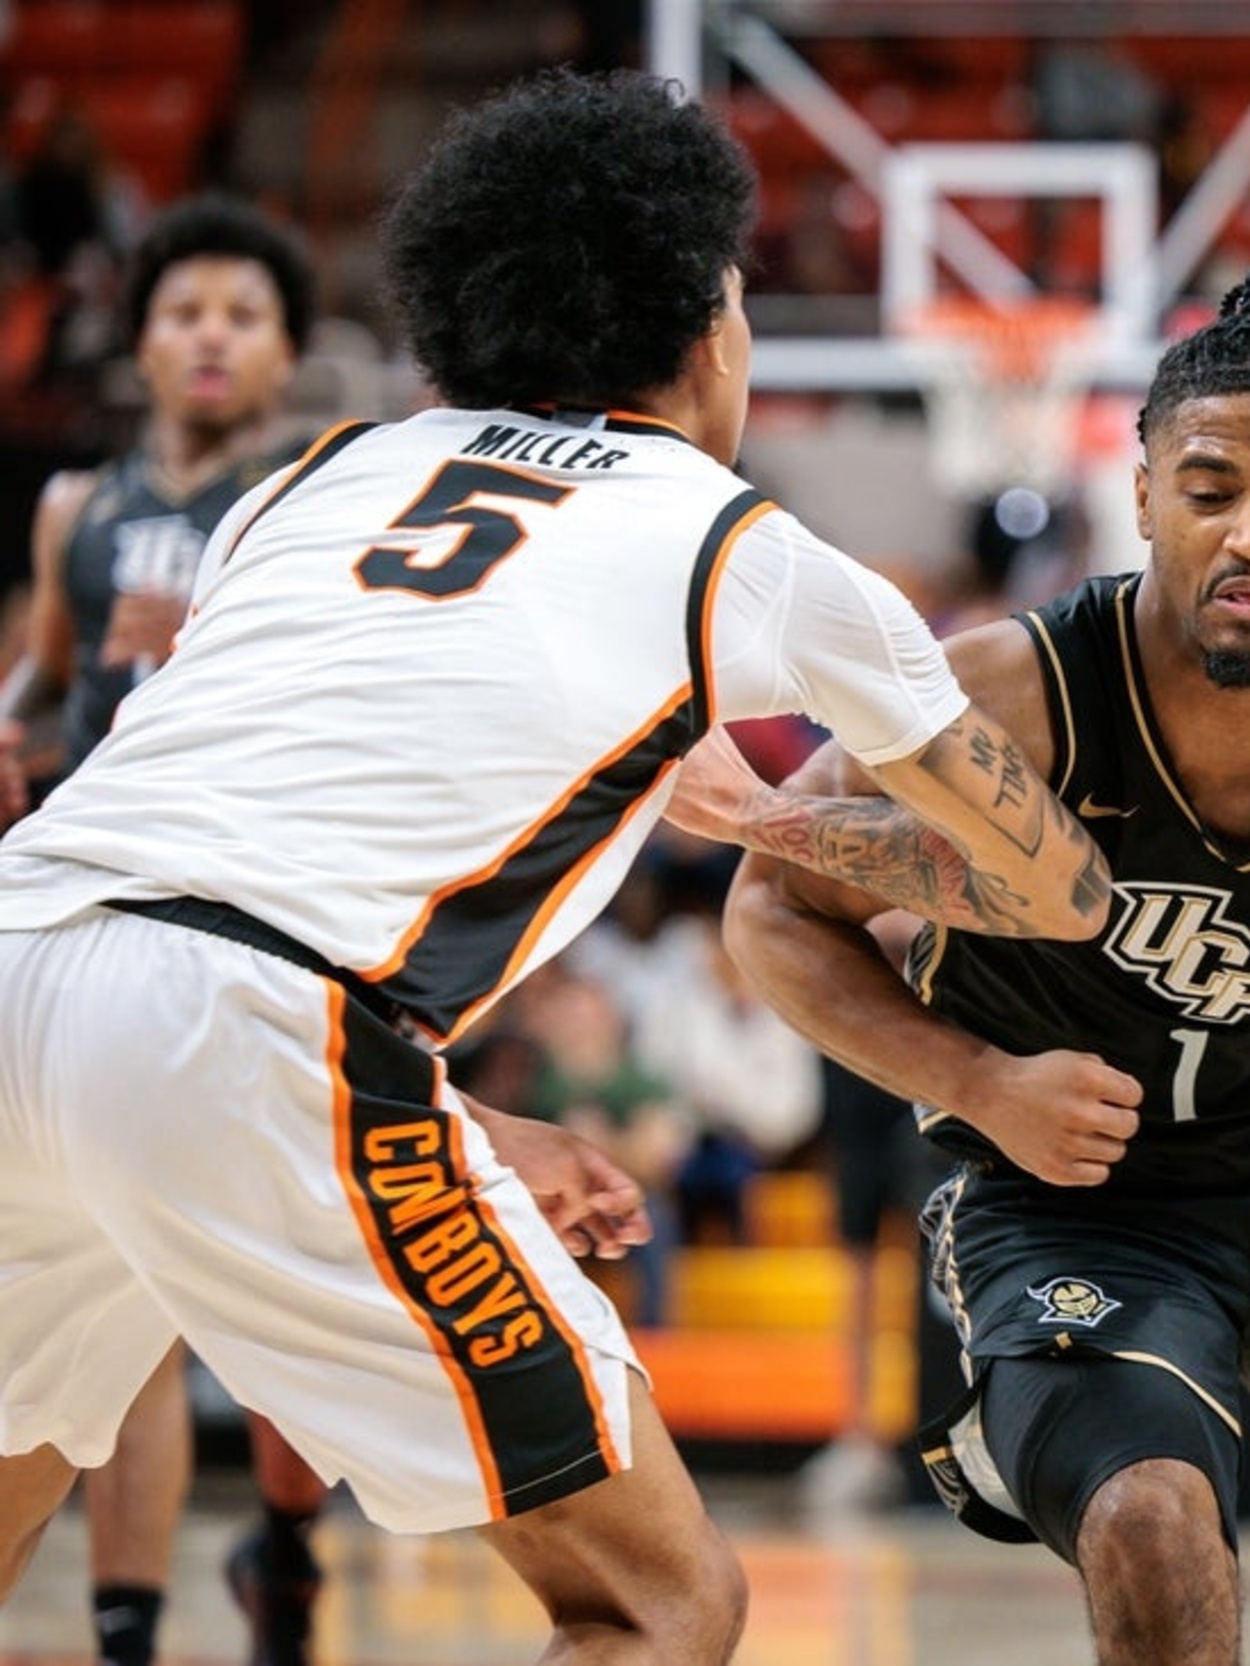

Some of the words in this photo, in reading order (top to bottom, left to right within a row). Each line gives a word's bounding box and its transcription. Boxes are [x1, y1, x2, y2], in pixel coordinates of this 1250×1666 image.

[461, 424, 630, 469] MILLER
[352, 457, 578, 603] 5
[1170, 1027, 1209, 1123] 1
